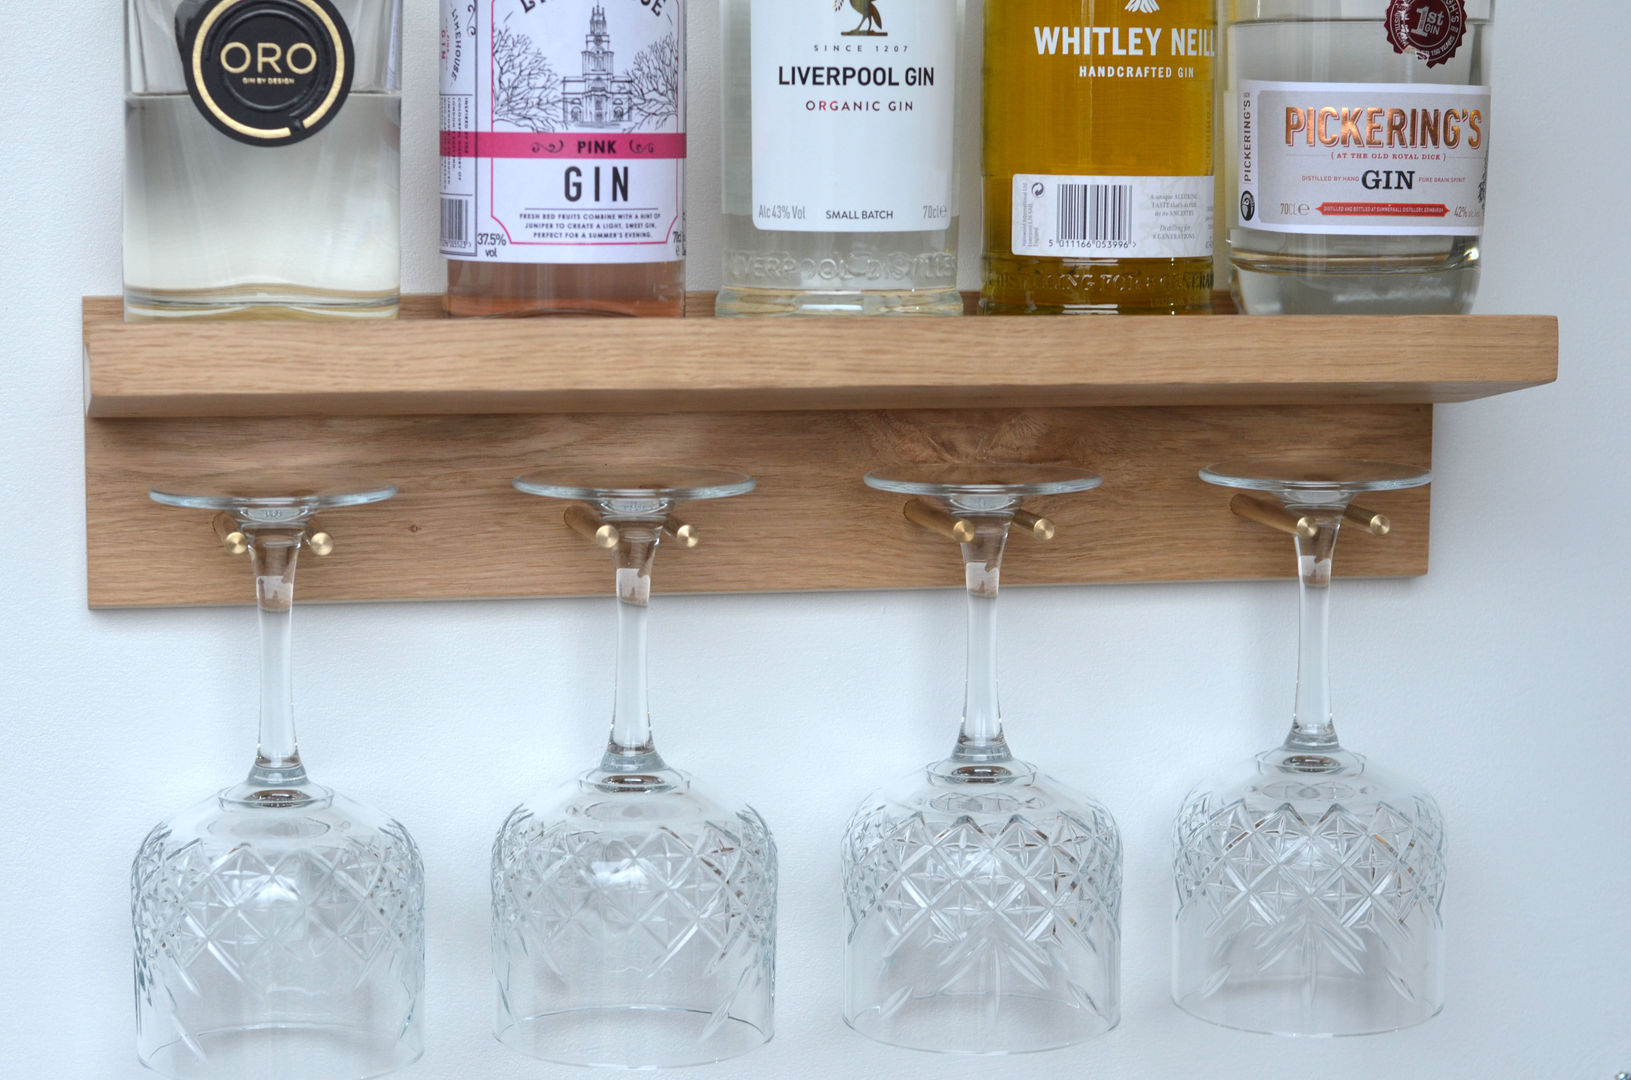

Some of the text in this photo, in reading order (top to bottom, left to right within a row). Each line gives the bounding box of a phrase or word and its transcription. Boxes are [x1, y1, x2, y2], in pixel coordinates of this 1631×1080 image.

[1425, 23, 1441, 35] GIN
[451, 8, 462, 82] LIMEHOUSE
[1033, 26, 1215, 56] WHITLEY NEILL
[813, 44, 909, 53] SINCE 1207
[220, 41, 317, 75] ORO
[778, 66, 934, 86] LIVERPOOL GIN
[1079, 66, 1194, 78] HANDCRAFTED GIN
[805, 101, 914, 112] ORGANIC GIN
[1285, 106, 1482, 150] PICKERING'S
[577, 140, 617, 154] PINK
[1243, 99, 1251, 182] PICKERING'S
[564, 166, 629, 203] GIN
[1361, 169, 1416, 190] GIN
[758, 205, 806, 220] Alc 43% Vol
[825, 210, 893, 219] SMALL BATCH
[477, 232, 507, 246] 37.5%
[1048, 239, 1129, 248] 5 011166 053996
[484, 247, 498, 257] vol
